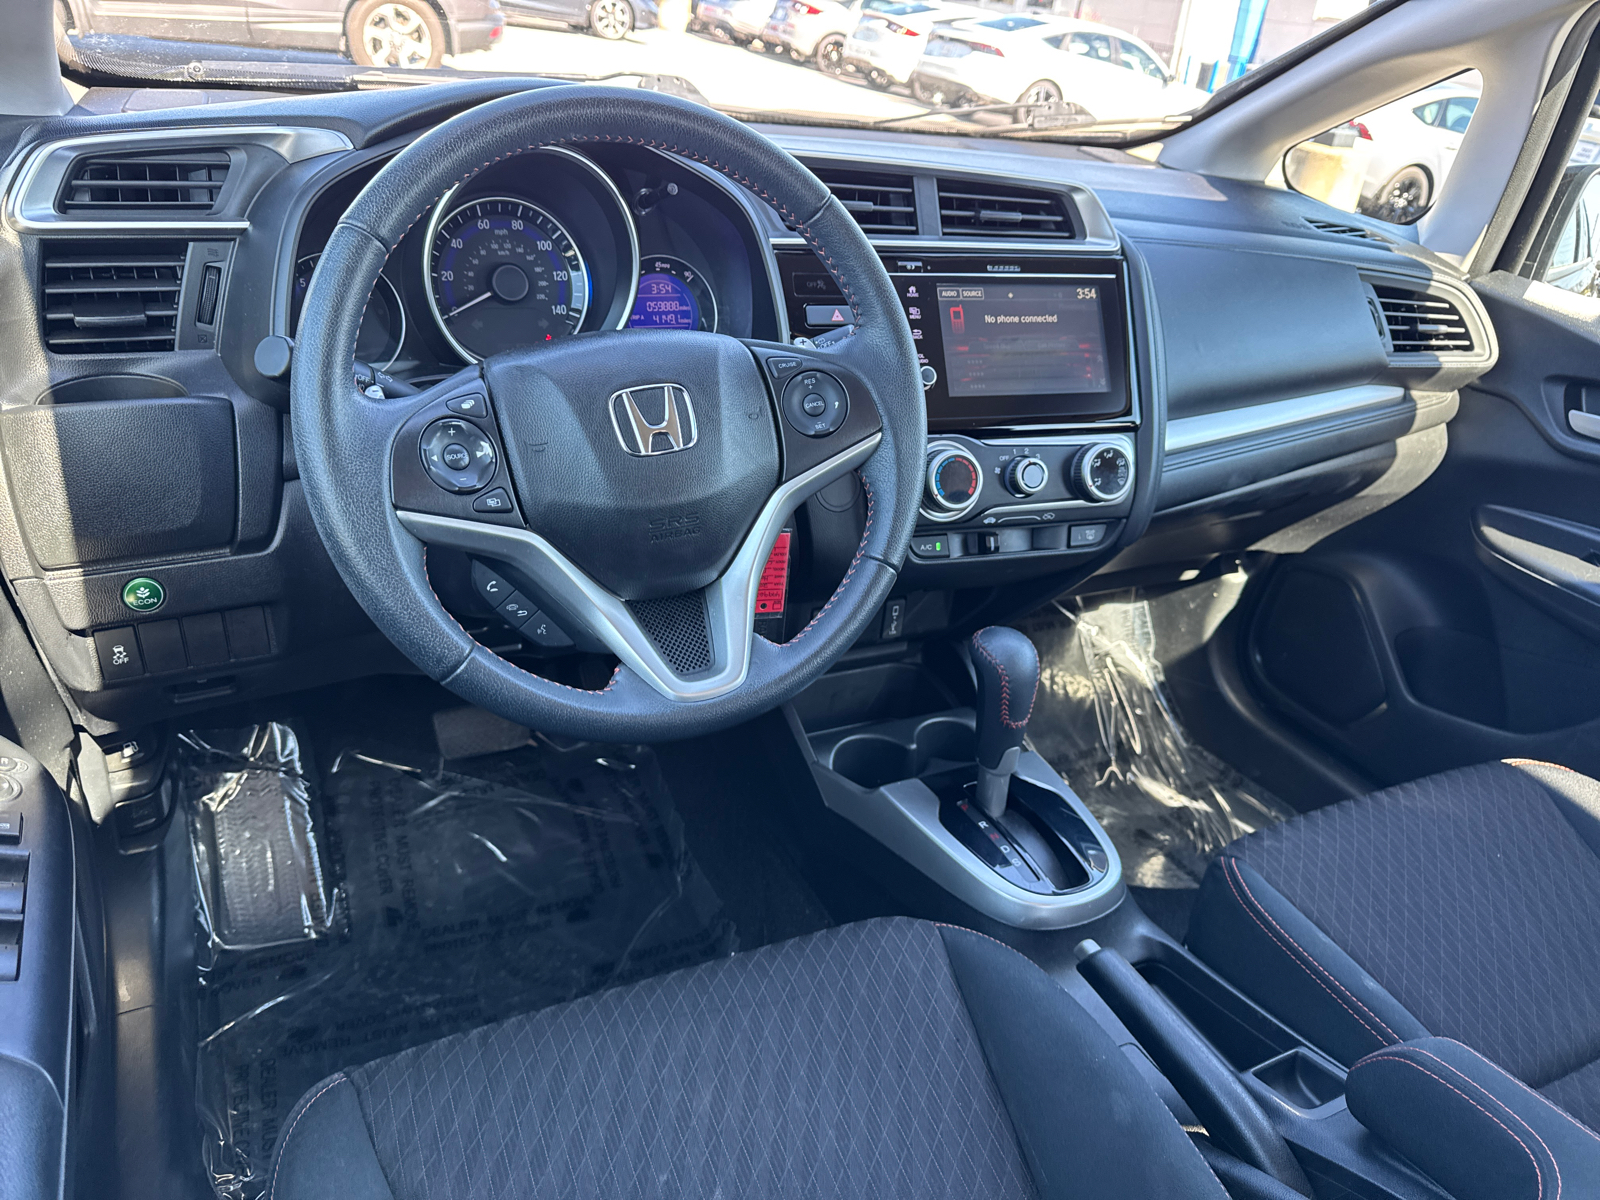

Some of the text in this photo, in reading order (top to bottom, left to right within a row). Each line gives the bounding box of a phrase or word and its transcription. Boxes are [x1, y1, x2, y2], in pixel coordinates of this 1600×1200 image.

[477, 219, 490, 230] 60
[511, 219, 524, 231] 80
[494, 228, 509, 236] mph
[450, 238, 463, 249] 40
[536, 240, 553, 251] 100
[441, 270, 454, 281] 20
[552, 270, 568, 281] 120
[299, 278, 306, 288] 5
[651, 284, 672, 295] 3:54
[1076, 288, 1097, 300] 3:54
[551, 304, 568, 315] 140
[985, 314, 1058, 324] No phone connected
[778, 361, 797, 369] CRUISE
[357, 373, 371, 382] OFF
[805, 400, 824, 409] CANCEL
[1024, 447, 1030, 455] 2
[649, 513, 700, 533] SRS
[650, 526, 701, 543] AIRBAG
[920, 543, 933, 551] A/C
[132, 597, 157, 606] ECON
[113, 657, 129, 665] OFF
[978, 820, 988, 829] R
[396, 835, 413, 871] MUST
[1000, 845, 1010, 853] D
[1011, 858, 1022, 867] S
[376, 854, 394, 896] COVER
[400, 878, 421, 932] REMOVE
[335, 1012, 386, 1032] COVER
[361, 1024, 408, 1043] MUST
[260, 1059, 278, 1109] DEALER
